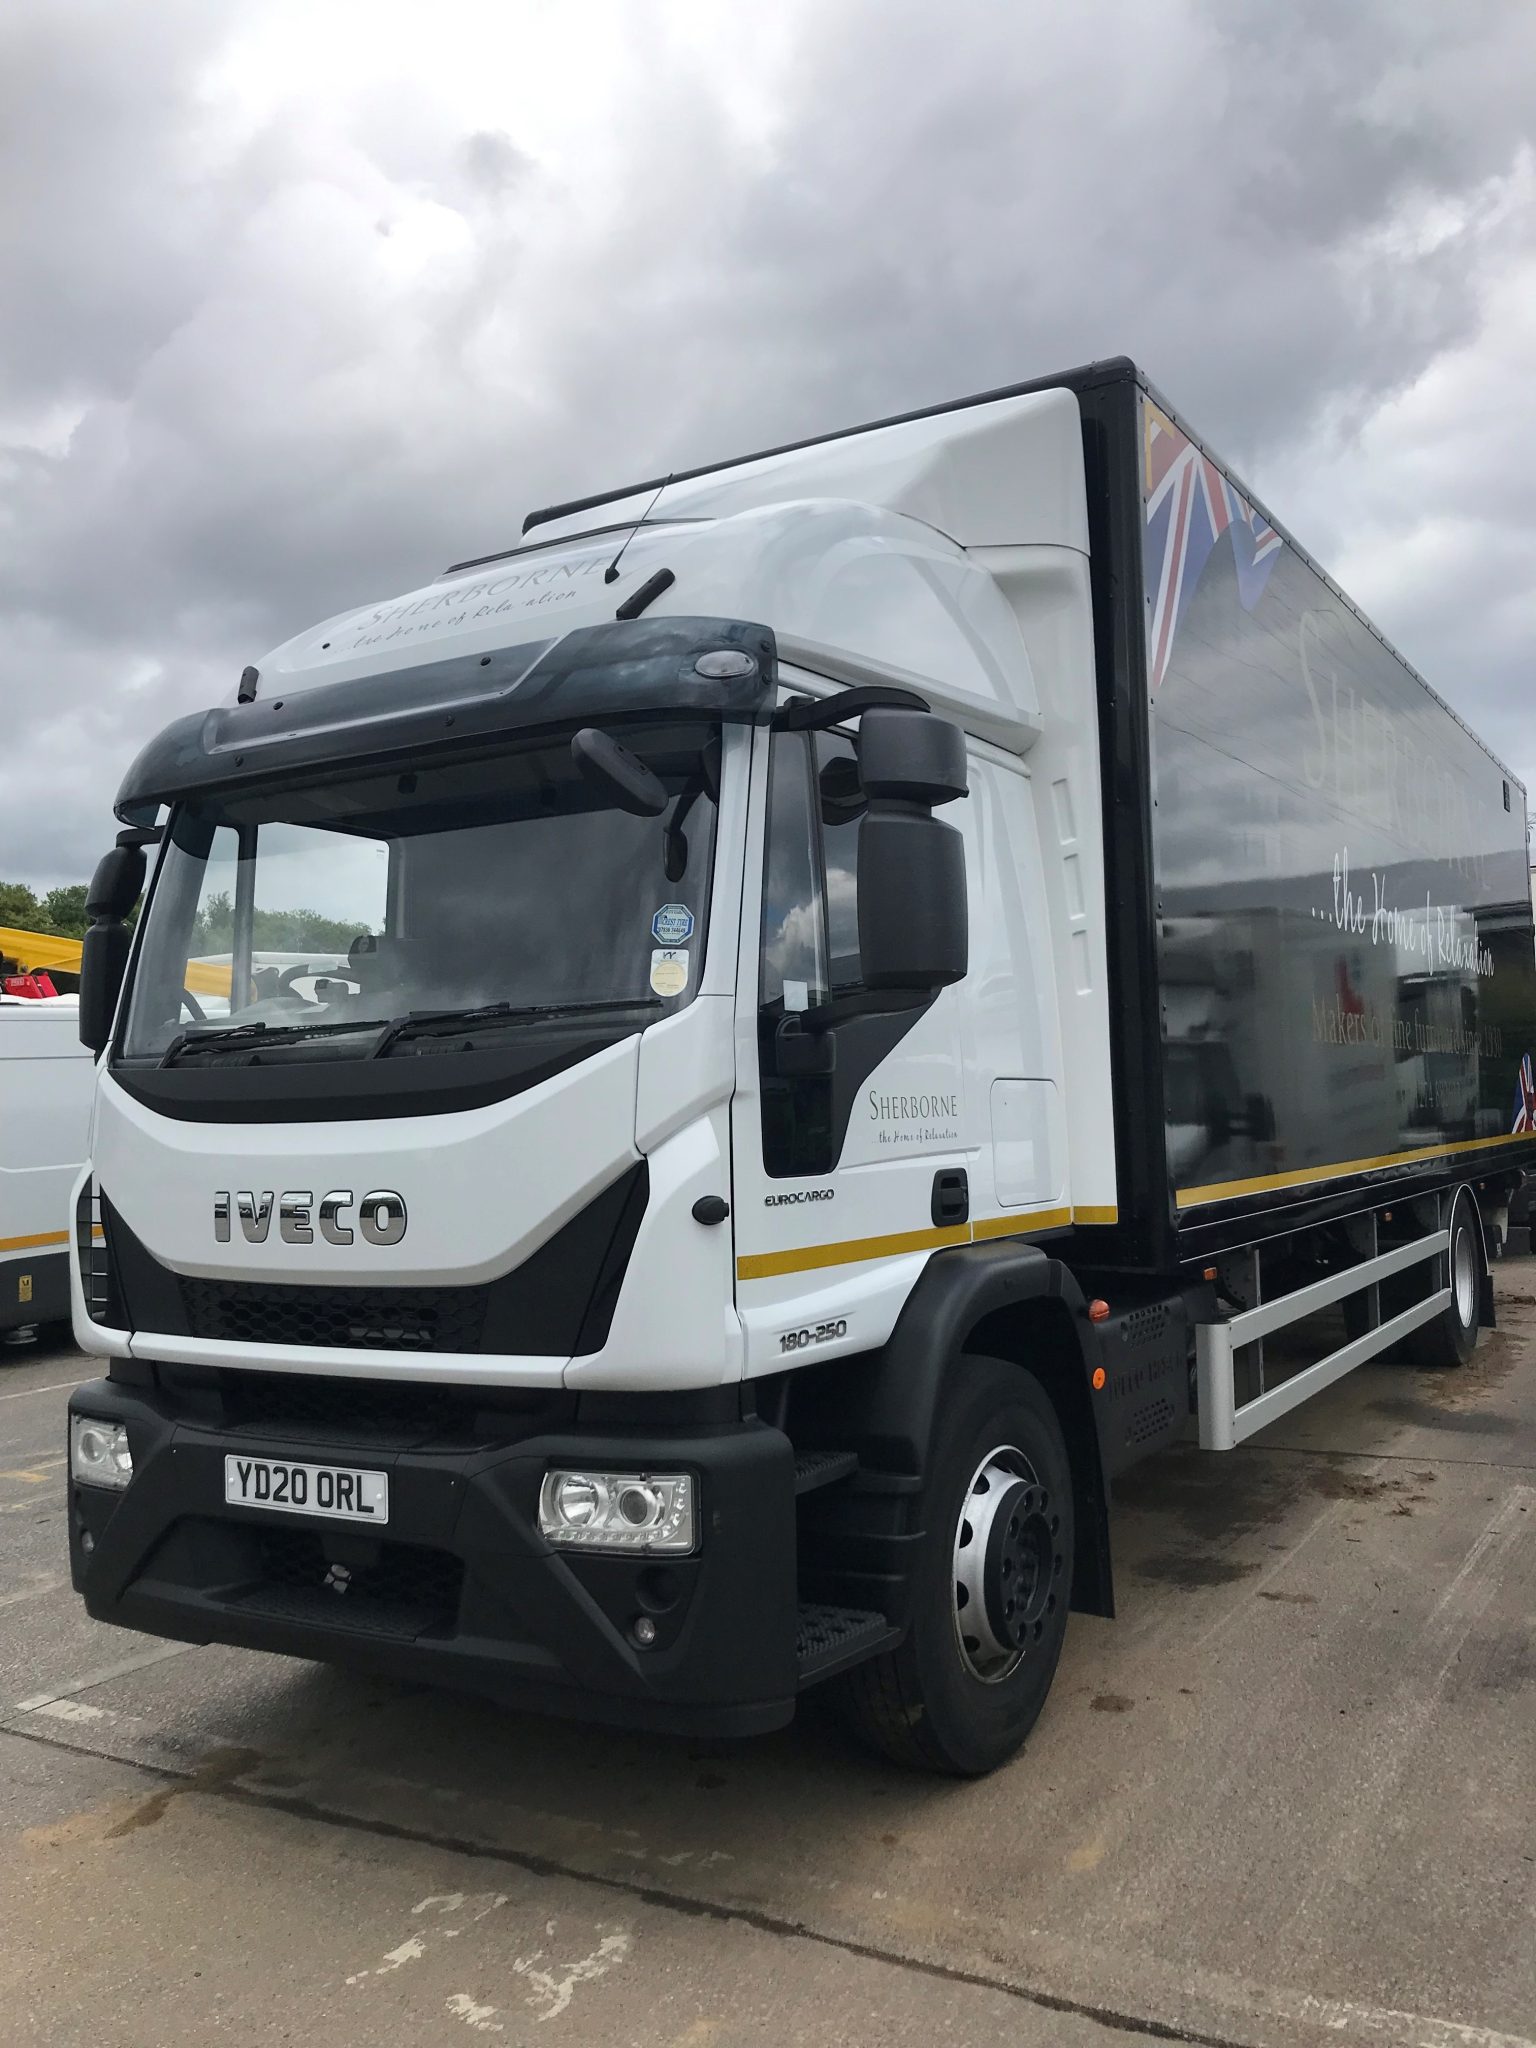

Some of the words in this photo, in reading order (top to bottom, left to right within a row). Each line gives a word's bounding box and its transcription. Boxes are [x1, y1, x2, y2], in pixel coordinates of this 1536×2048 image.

[357, 557, 608, 631] SHERBORNE
[447, 611, 467, 626] of
[1371, 872, 1417, 950] Home
[1420, 890, 1433, 977] of
[1437, 905, 1495, 978] Relaxation
[1311, 992, 1367, 1045] Makers
[869, 1090, 958, 1120] SHERBORNE
[893, 1130, 914, 1144] Home
[916, 1127, 923, 1144] of
[213, 1188, 408, 1247] IVECO
[764, 1188, 836, 1207] EUROCARGO
[779, 1319, 848, 1354] 180-250
[236, 1460, 309, 1506] YD20
[316, 1470, 376, 1514] ORL
